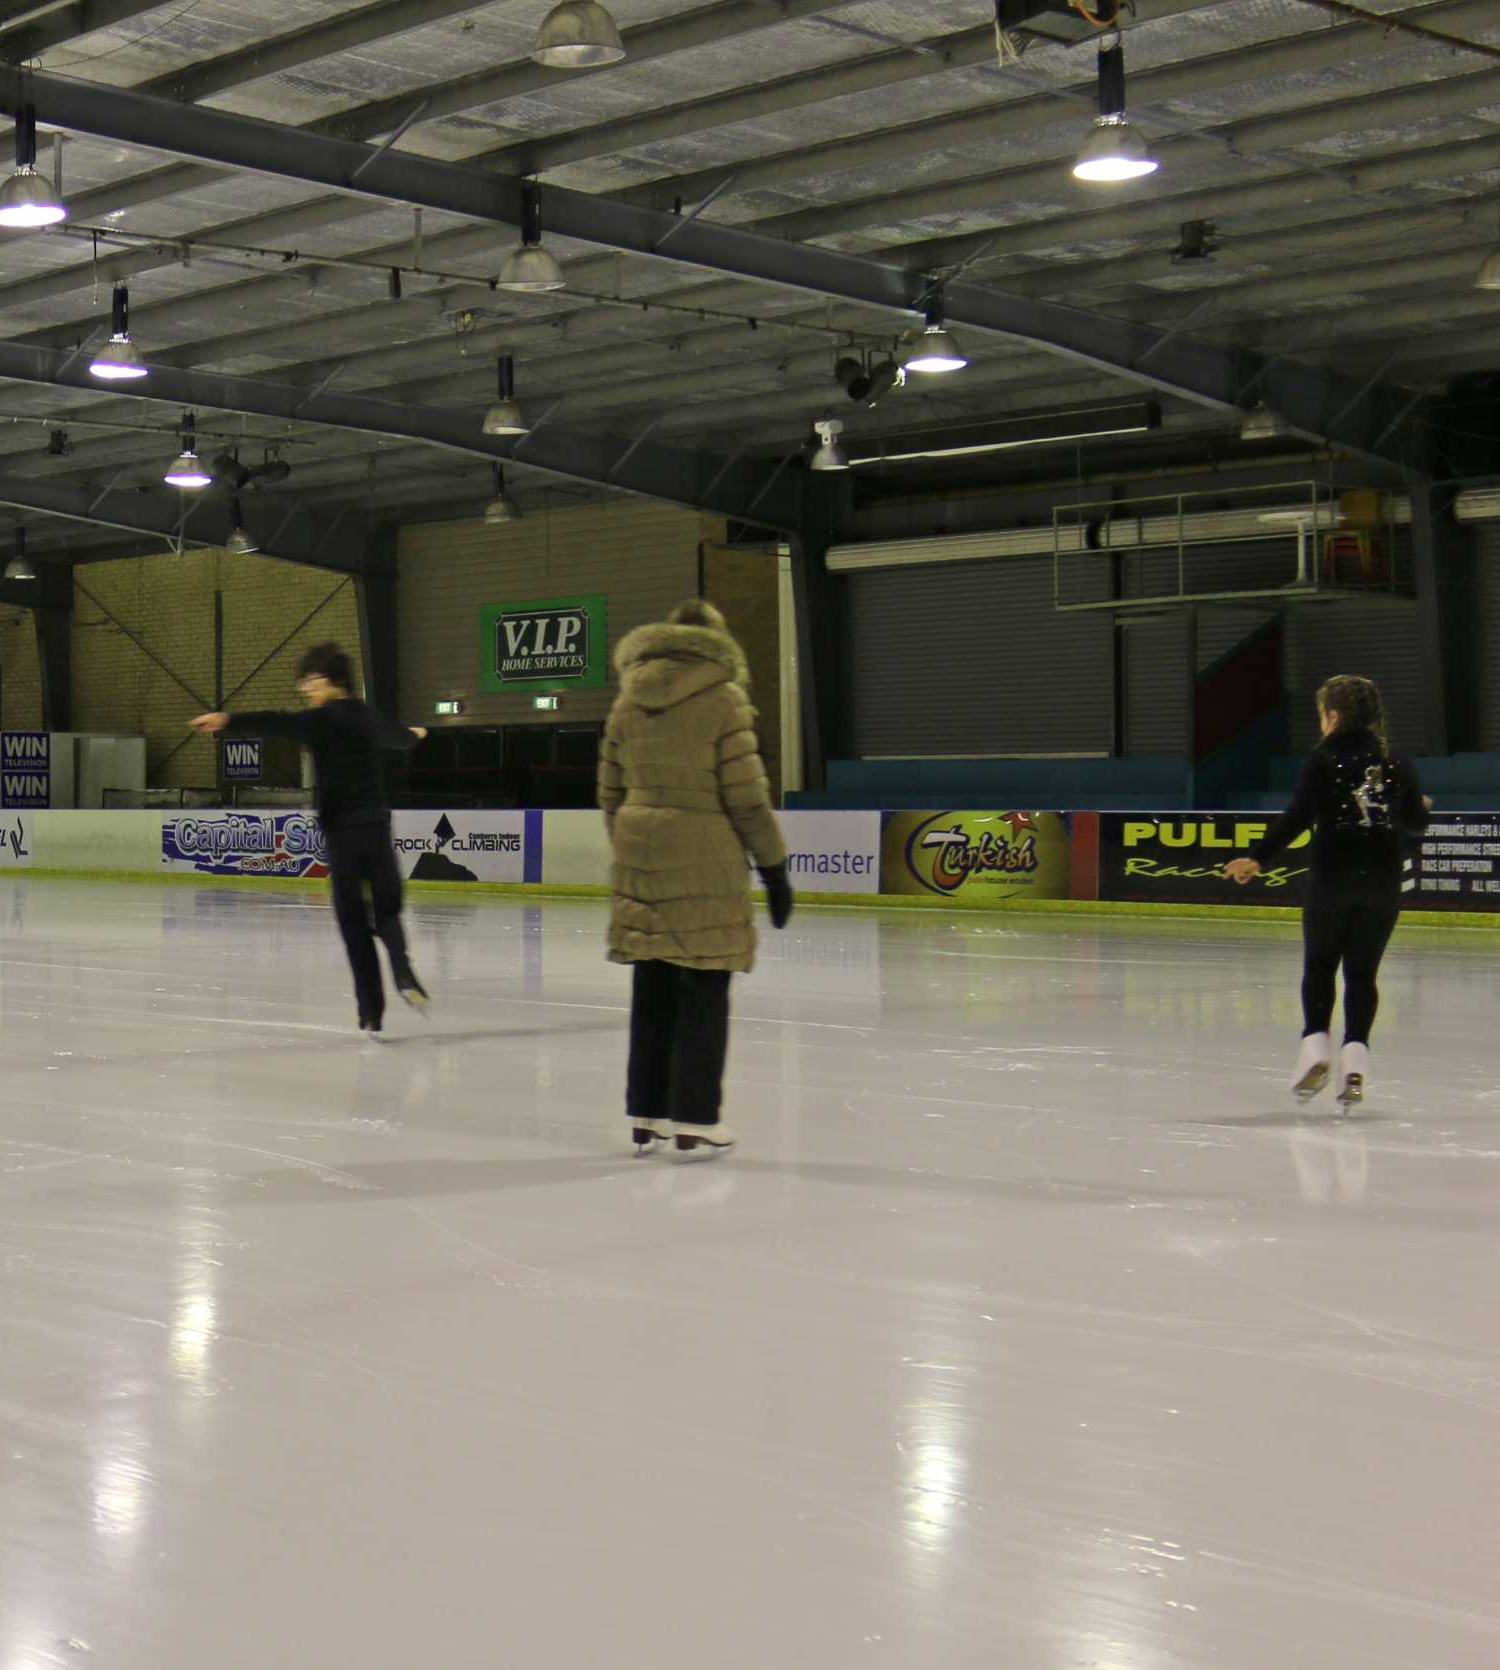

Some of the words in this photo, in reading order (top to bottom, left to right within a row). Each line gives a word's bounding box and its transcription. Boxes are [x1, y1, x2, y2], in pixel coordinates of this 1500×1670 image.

[503, 616, 581, 657] V.I.P.
[502, 658, 533, 671] HOME
[534, 655, 584, 669] SERVICES
[4, 735, 47, 757] WIN
[226, 743, 259, 766] WIN
[4, 775, 47, 796] WIN
[179, 816, 275, 859] Capital
[394, 838, 432, 853] ROCK
[452, 839, 521, 852] CLIMBING
[788, 850, 875, 874] rmaster
[921, 825, 1038, 890] Turkish
[1125, 858, 1309, 886] Racig
